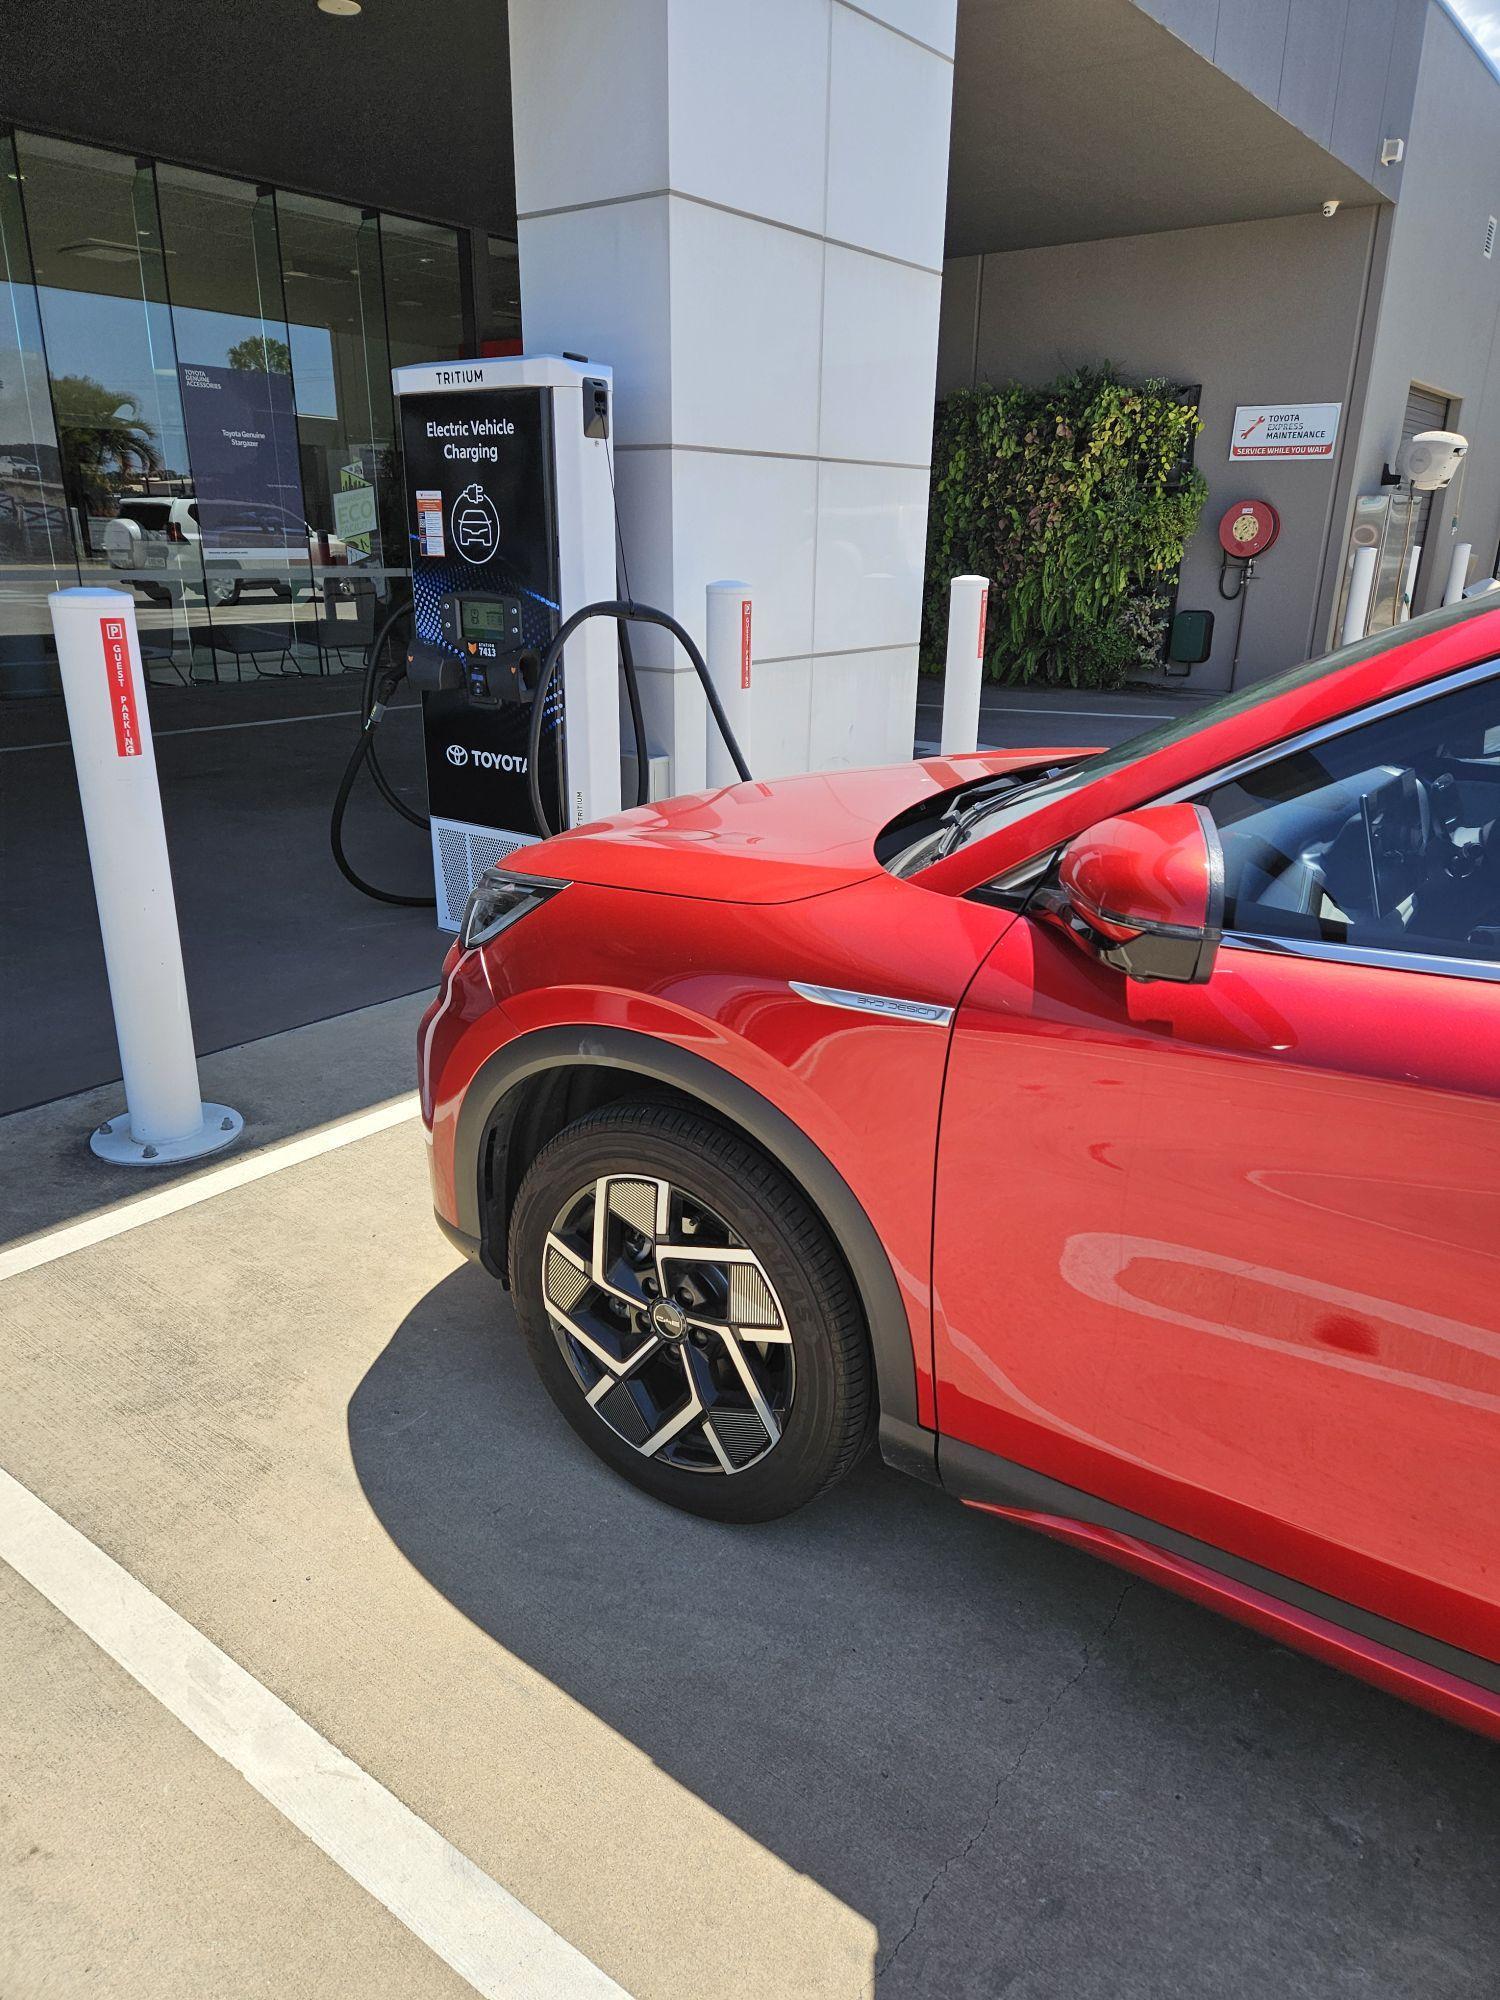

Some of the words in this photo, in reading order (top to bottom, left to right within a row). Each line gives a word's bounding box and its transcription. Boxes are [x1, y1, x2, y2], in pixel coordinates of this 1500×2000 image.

[186, 375, 210, 383] GENUINE
[436, 370, 483, 384] TRITIUM
[186, 380, 221, 389] ACCESSORIES
[1269, 414, 1300, 422] TOYOTA
[426, 420, 469, 437] Electric
[470, 418, 515, 435] Vehicle
[1267, 423, 1304, 431] EXPRESS
[222, 429, 241, 438] Toyota
[242, 431, 266, 439] Genuine
[1266, 430, 1326, 439] MAINTENANCE
[231, 439, 258, 447] Stargazer
[443, 443, 498, 462] Charging
[338, 500, 373, 525] ECO
[479, 648, 496, 657] 7413
[112, 644, 125, 688] GUEST
[120, 695, 136, 755] PARKING
[857, 997, 885, 1007] BYD
[888, 1002, 937, 1016] DESIGN
